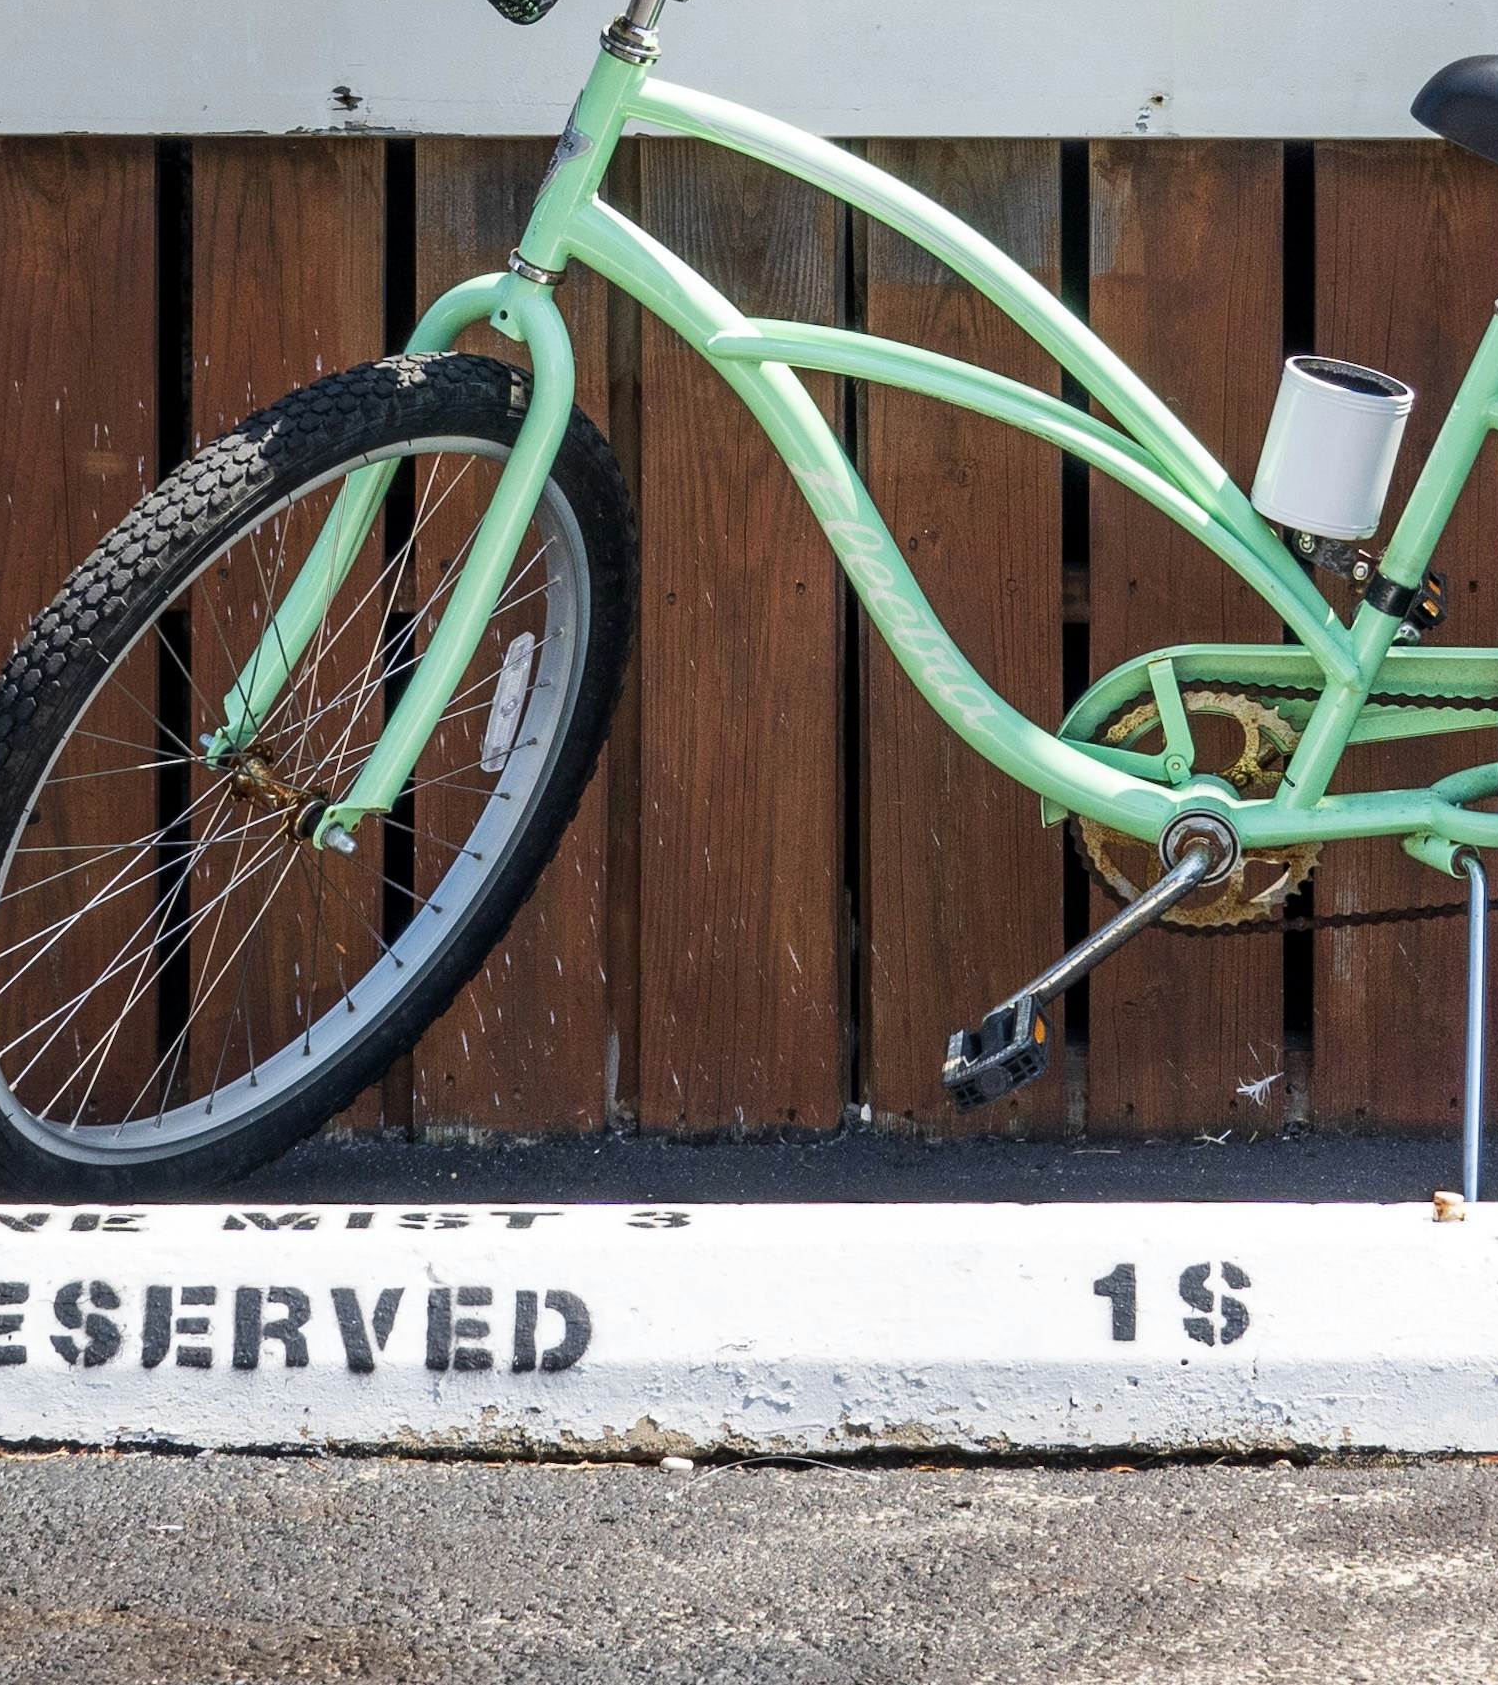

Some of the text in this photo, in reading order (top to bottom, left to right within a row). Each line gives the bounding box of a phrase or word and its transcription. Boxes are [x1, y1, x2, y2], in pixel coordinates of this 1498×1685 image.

[787, 460, 1000, 736] Electra
[222, 1211, 564, 1231] MIST
[625, 1211, 692, 1230] 3
